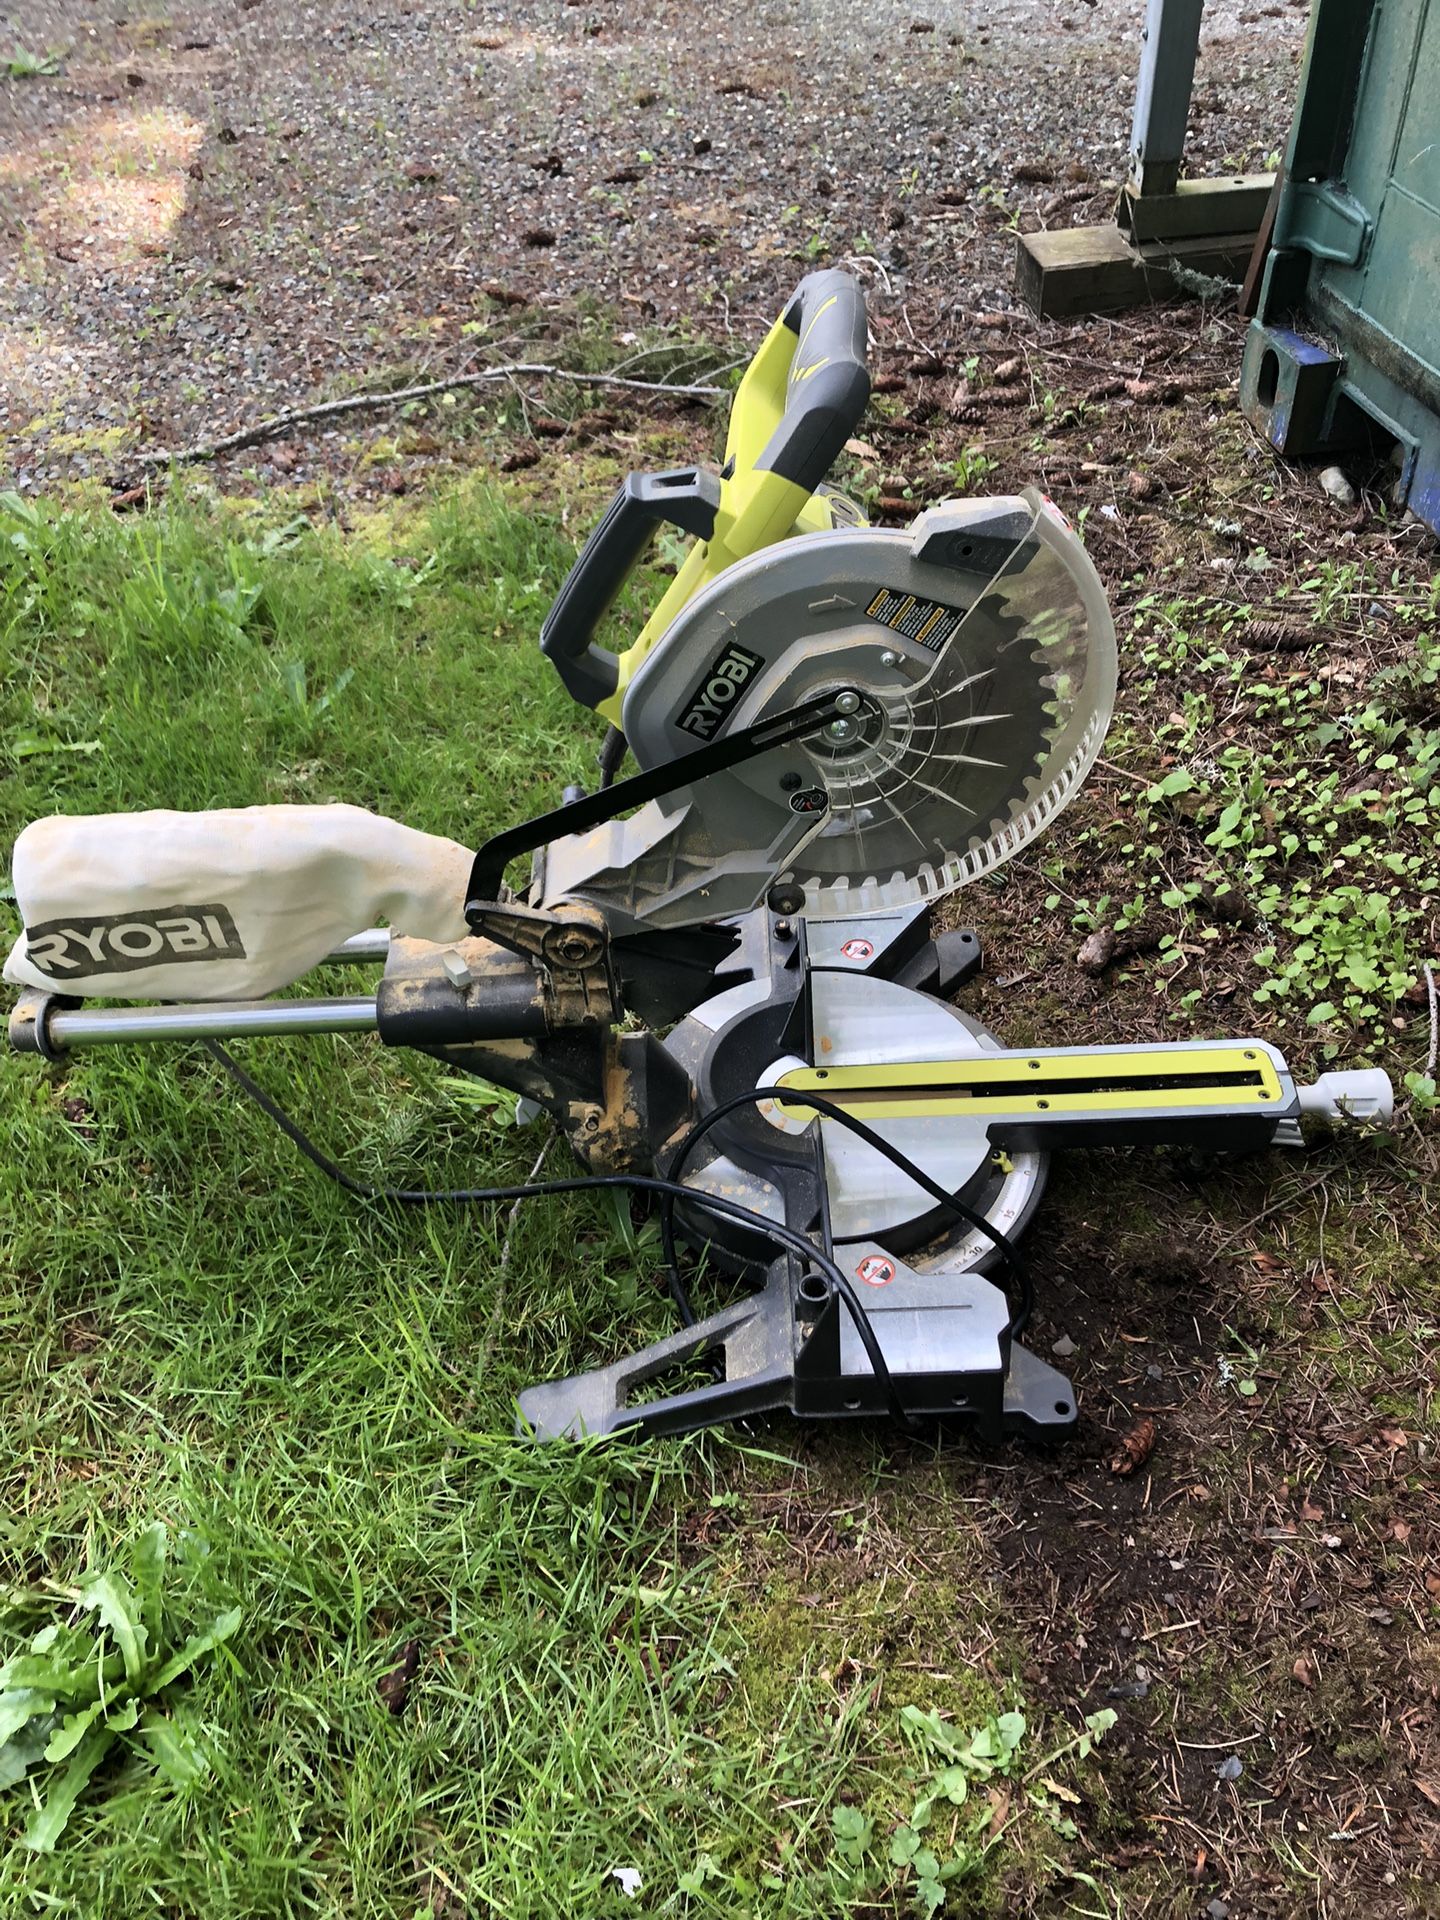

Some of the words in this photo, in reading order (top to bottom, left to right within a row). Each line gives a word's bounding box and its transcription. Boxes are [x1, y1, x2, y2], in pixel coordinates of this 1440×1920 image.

[682, 650, 756, 736] RYOBI
[28, 915, 230, 971] RYOBI
[1004, 1209, 1015, 1219] 15
[969, 1246, 983, 1257] 30
